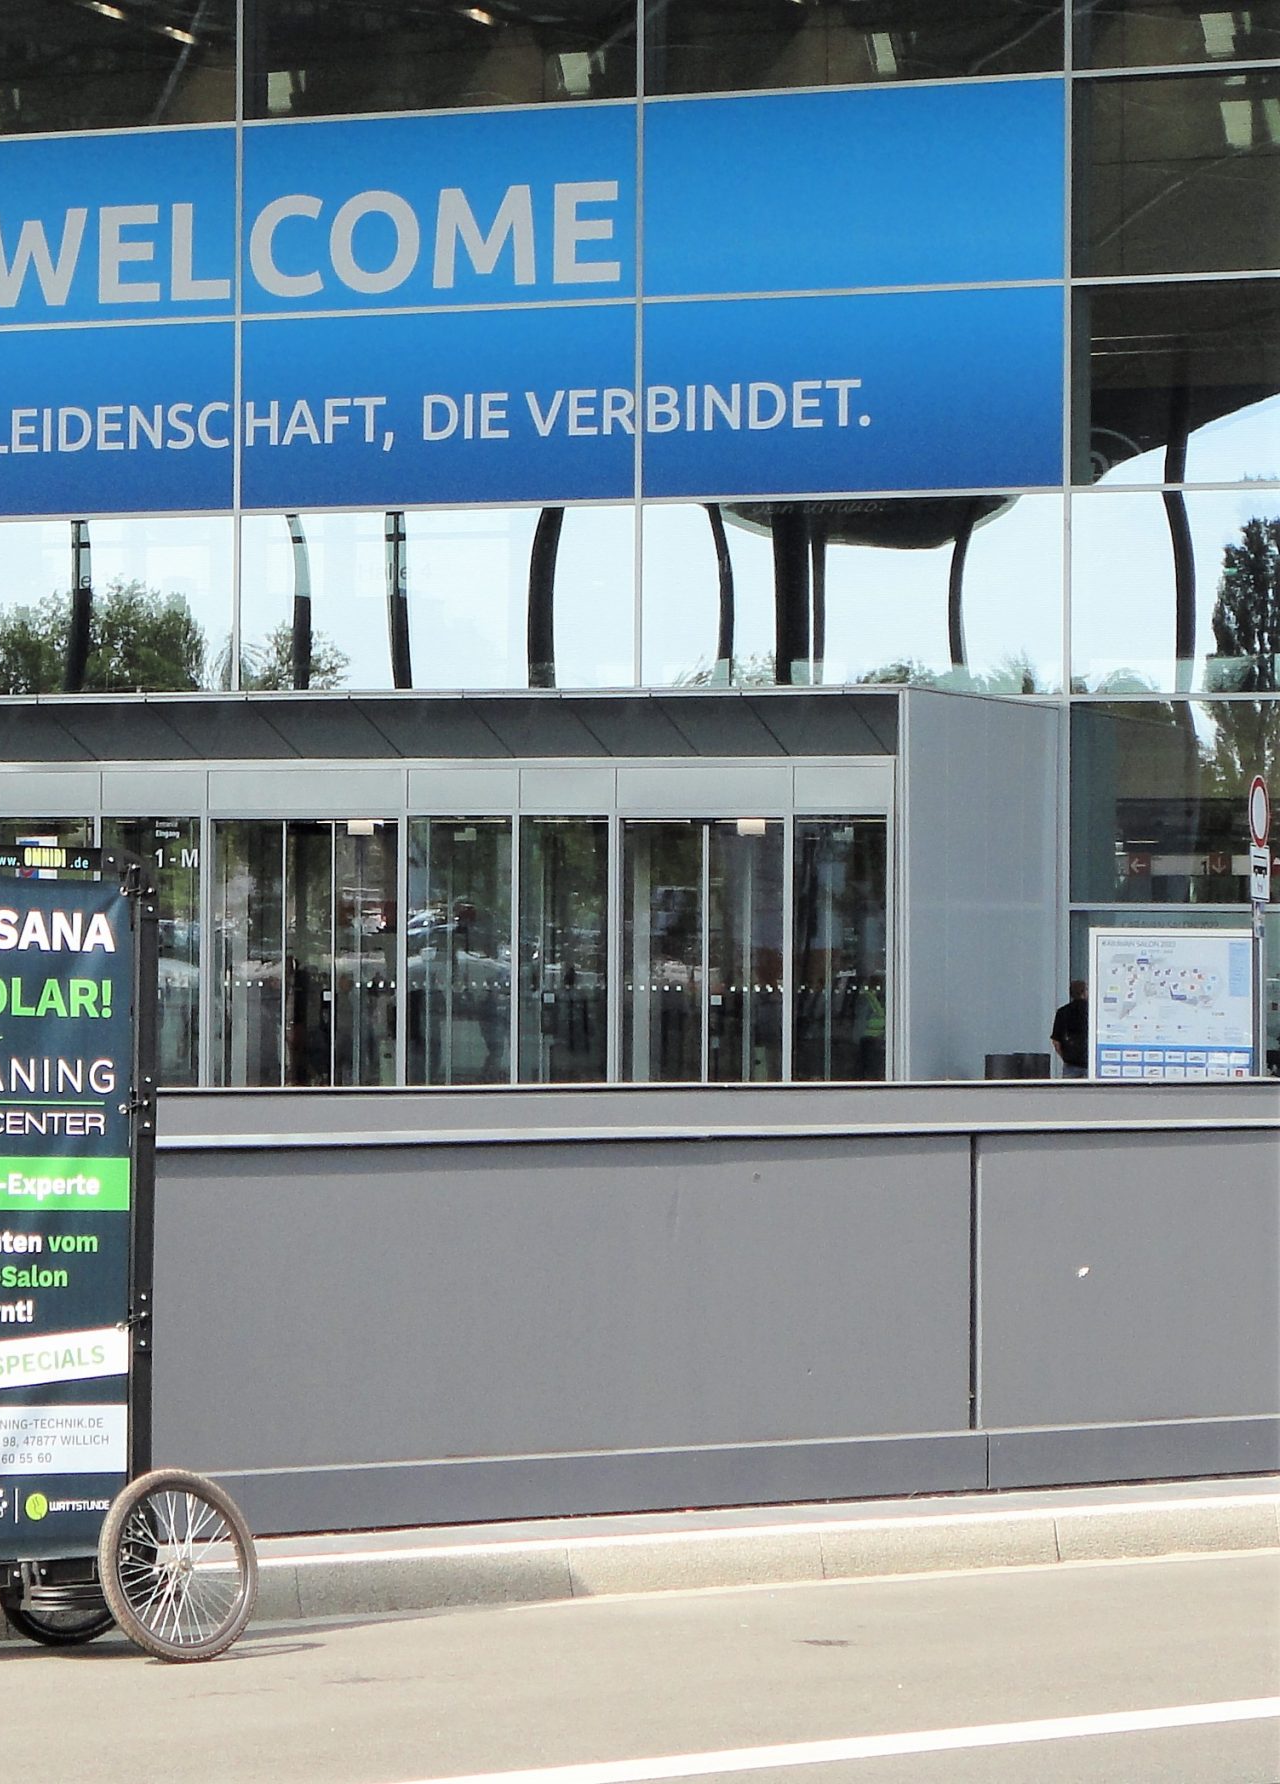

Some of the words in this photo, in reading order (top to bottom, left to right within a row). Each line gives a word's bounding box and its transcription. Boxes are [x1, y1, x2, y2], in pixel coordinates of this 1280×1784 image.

[423, 392, 509, 441] DIE
[525, 379, 871, 437] VERBINDET.
[70, 857, 89, 868] .de
[155, 848, 163, 868] 1
[47, 1235, 98, 1253] vom
[2, 1436, 19, 1449] 98,
[23, 1435, 57, 1447] 47877
[60, 1434, 110, 1446] WILLICH
[1, 1453, 15, 1465] 60
[19, 1453, 33, 1464] 55
[37, 1452, 52, 1464] 60
[49, 1499, 110, 1512] WATTSTUNDE
